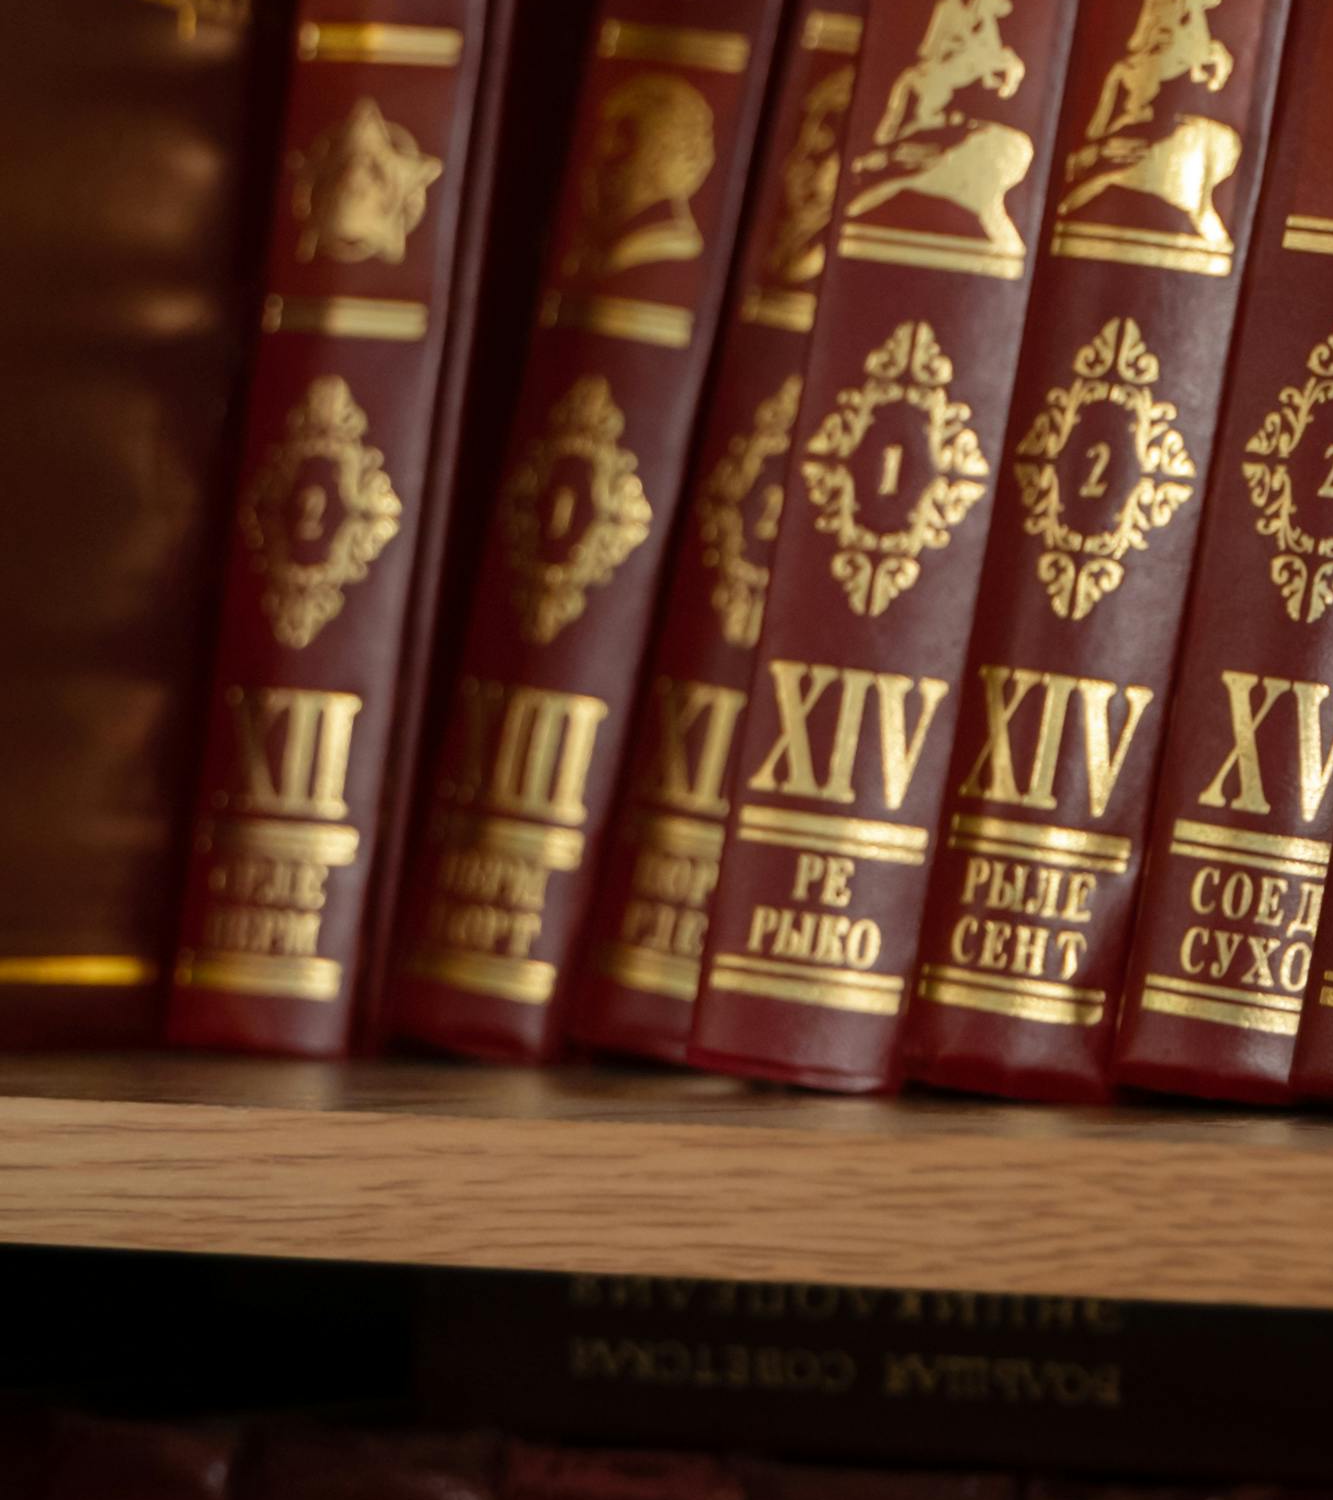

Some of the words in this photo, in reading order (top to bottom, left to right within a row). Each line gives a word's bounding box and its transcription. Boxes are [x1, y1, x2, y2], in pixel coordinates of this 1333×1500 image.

[877, 444, 904, 497] 1
[1079, 443, 1111, 498] 2
[747, 659, 950, 811] XIV
[959, 664, 1154, 818] XIV
[791, 854, 855, 908] РЕ
[960, 857, 1098, 922] РЫЛЕ
[747, 906, 884, 970] РЫКО
[950, 918, 1088, 981] СЕНТ
[1178, 924, 1313, 994] СУХО
